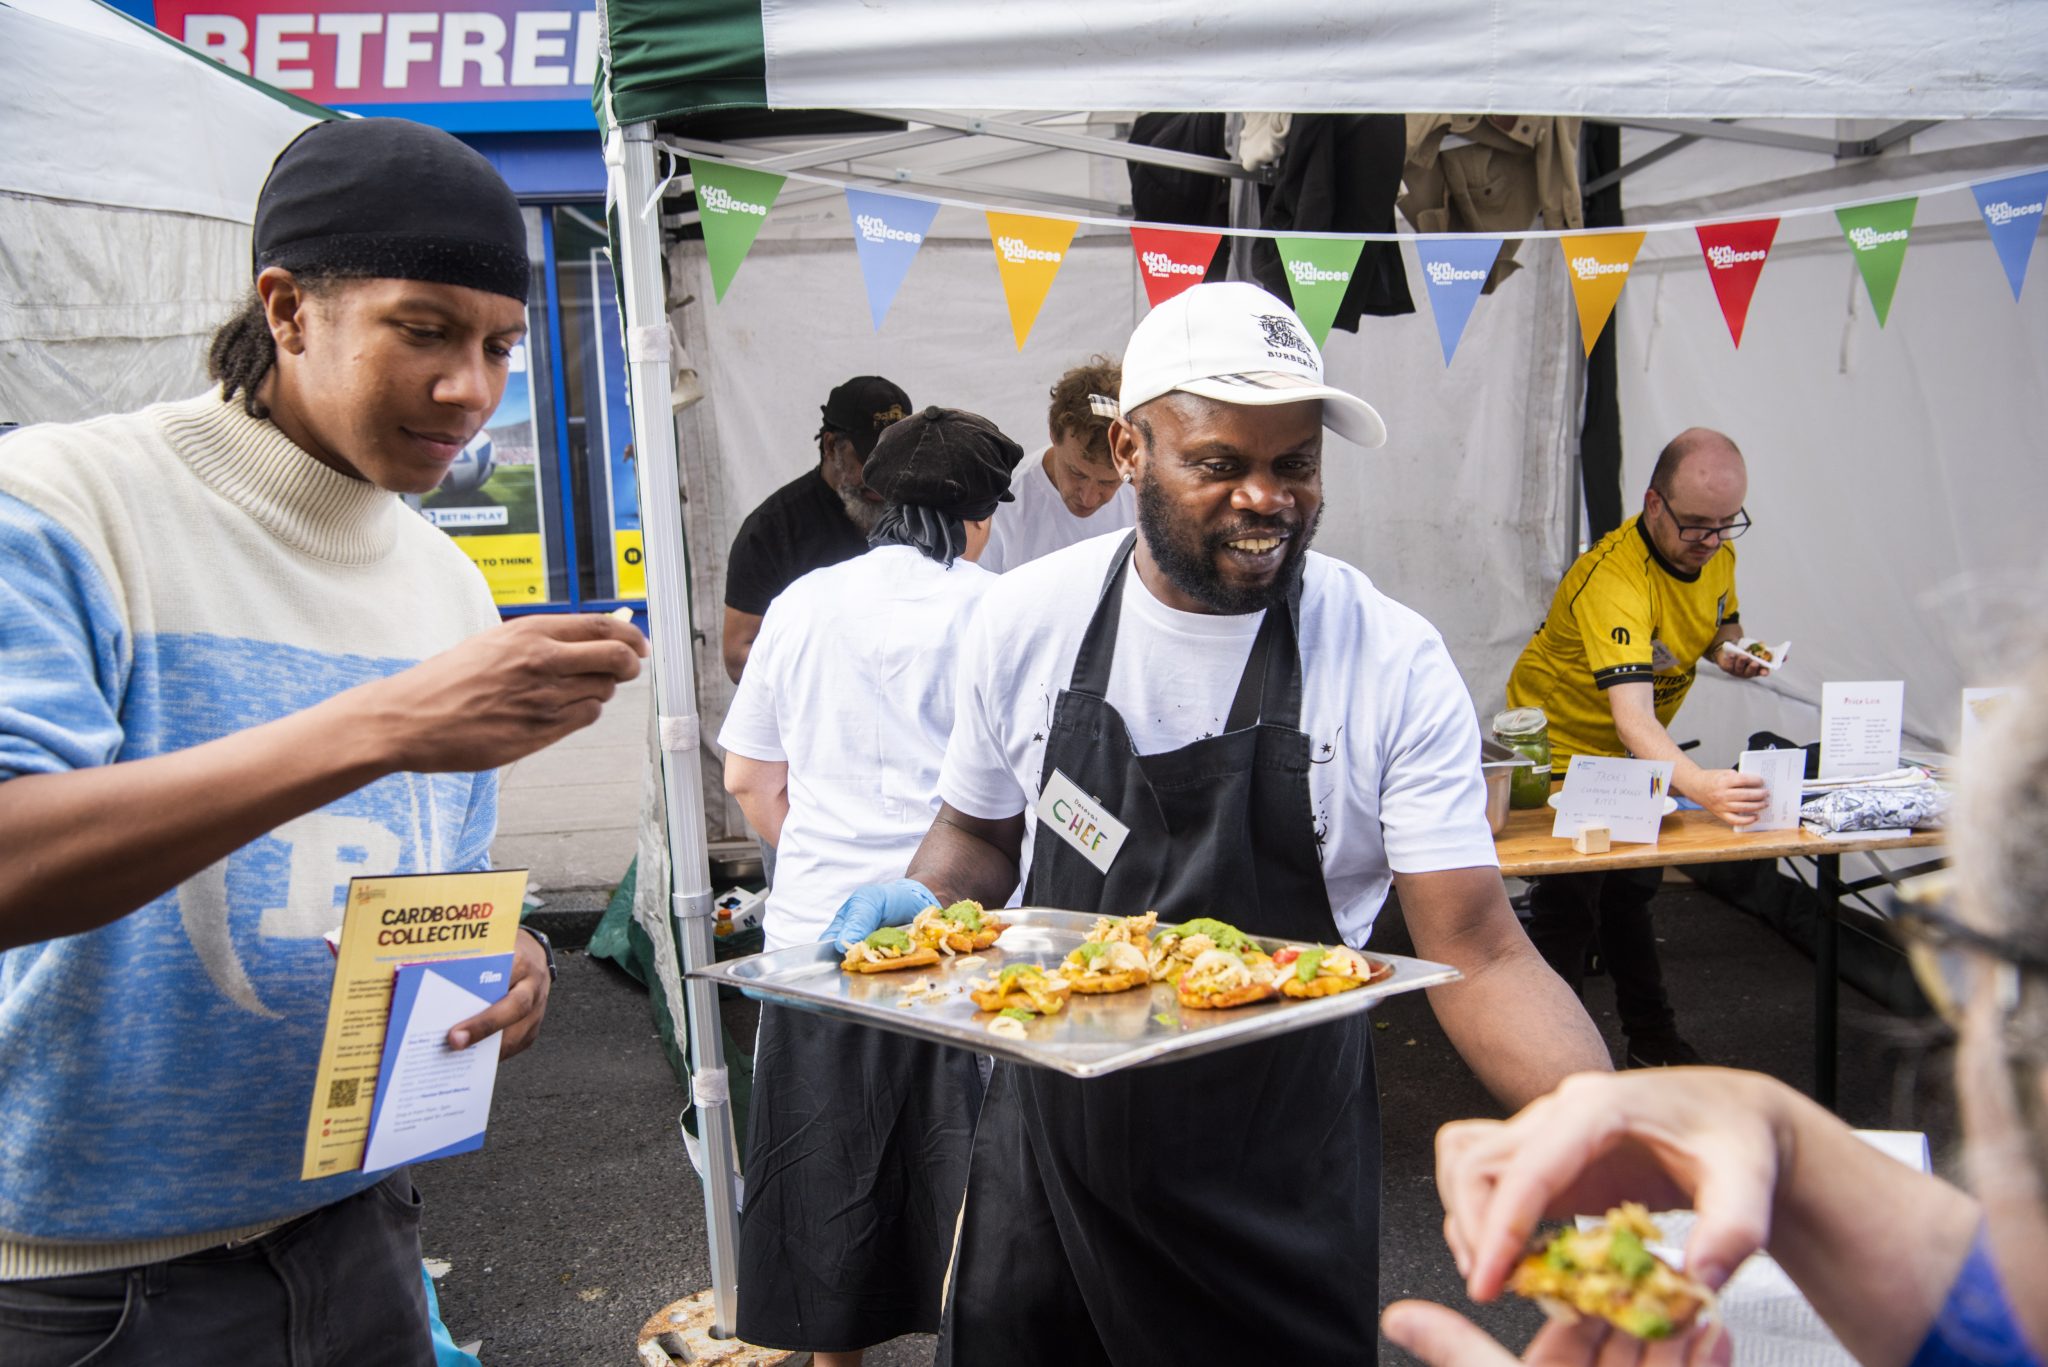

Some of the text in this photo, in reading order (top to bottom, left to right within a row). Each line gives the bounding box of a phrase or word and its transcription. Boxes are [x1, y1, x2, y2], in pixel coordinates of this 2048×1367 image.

[706, 195, 768, 216] palaces
[1991, 202, 2043, 224] palaces
[862, 224, 922, 244] palaces
[1856, 230, 1908, 249] palaces
[1003, 245, 1062, 263] palaces
[1713, 249, 1766, 268] palaces
[1148, 259, 1204, 276] palaces
[1295, 267, 1349, 283] palaces
[1432, 267, 1486, 283] palaces
[1577, 262, 1629, 279] palaces
[438, 511, 503, 522] BET IN-PLAY
[483, 558, 497, 567] TO
[499, 556, 533, 566] THINK
[1052, 798, 1109, 852] CHEF
[381, 902, 495, 926] CARDBOARD
[377, 921, 490, 946] COLLECTIVE
[479, 971, 502, 984] film
